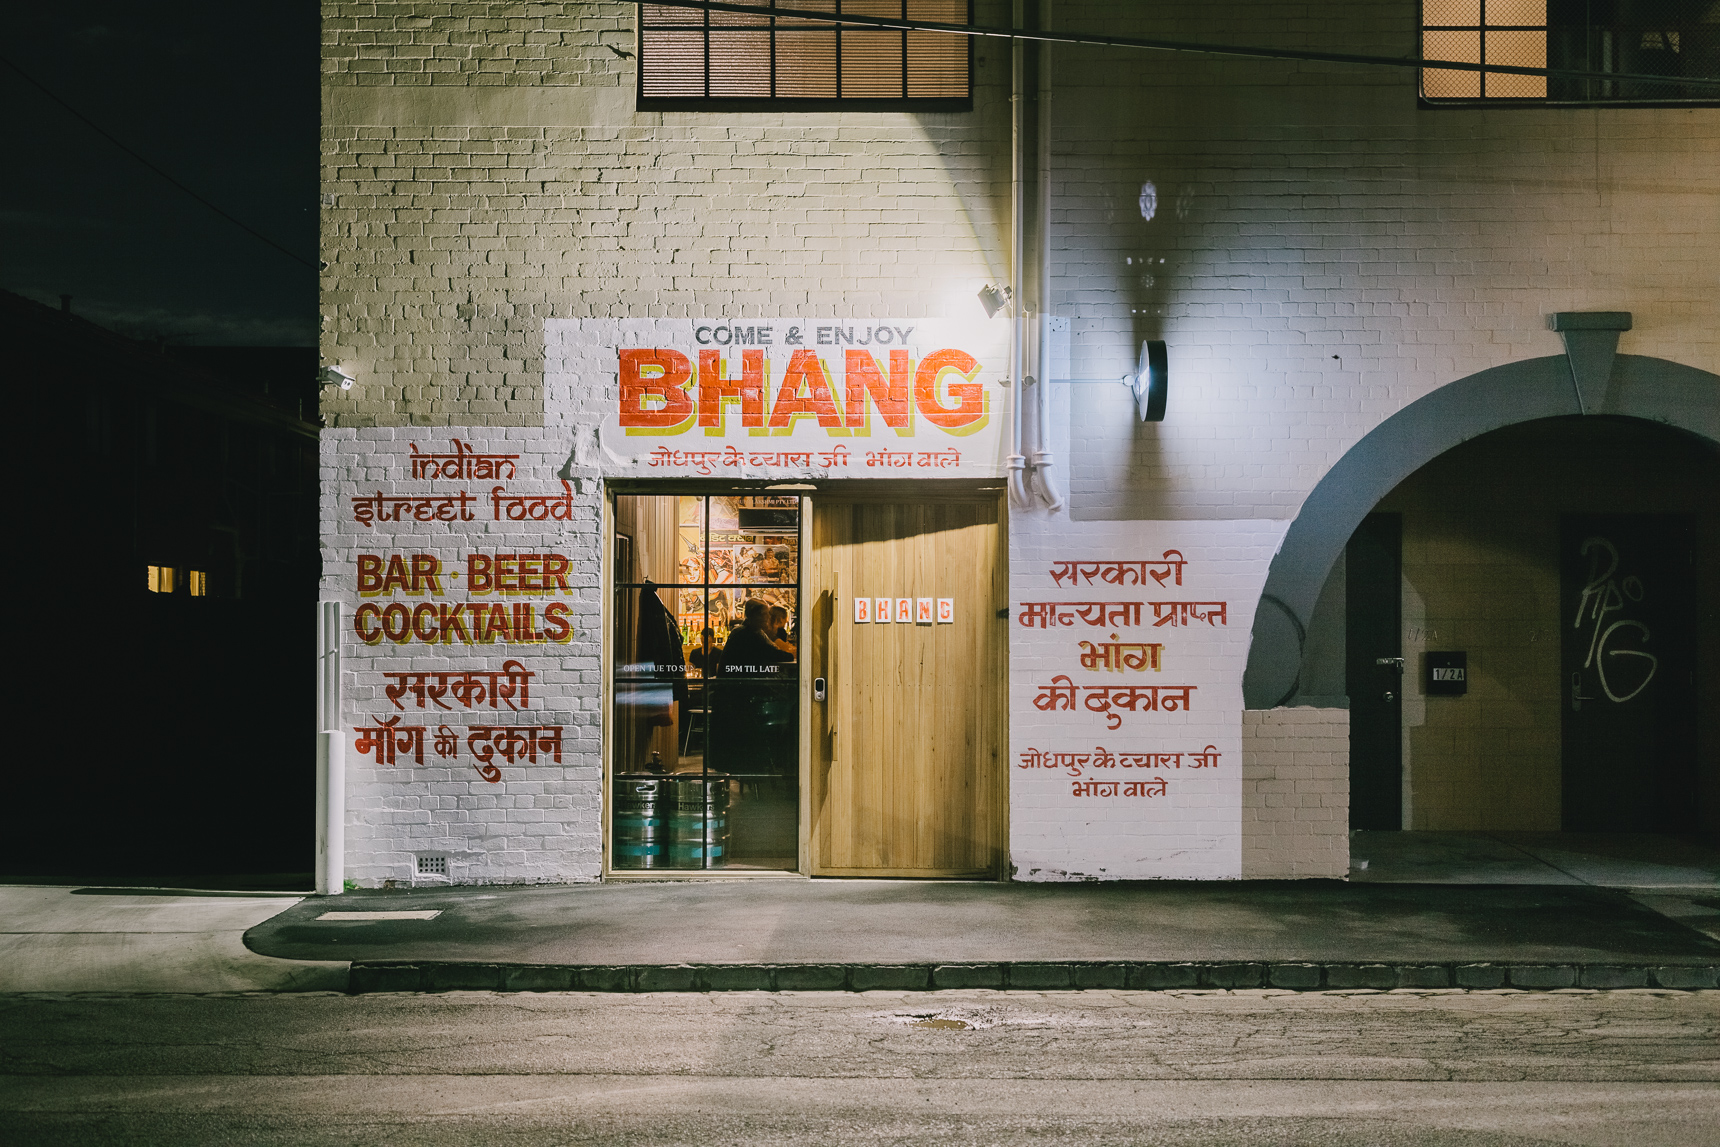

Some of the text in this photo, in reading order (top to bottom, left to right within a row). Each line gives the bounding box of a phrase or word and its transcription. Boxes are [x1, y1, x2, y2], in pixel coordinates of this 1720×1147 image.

[695, 325, 915, 346] COME & ENJOY
[618, 348, 989, 438] BHANG
[409, 438, 520, 480] indian
[722, 445, 746, 468] के
[818, 444, 851, 468] जी
[917, 447, 962, 468] वाले
[351, 478, 574, 527] street food
[357, 553, 445, 597] BAR
[467, 553, 573, 596] BEER
[1049, 549, 1188, 588] सरकारी
[354, 602, 574, 646] COCKTAILS
[858, 599, 951, 620] BHANG
[1018, 601, 1227, 629] मान्यता प्राप्त
[623, 664, 696, 673] OPEN TUE TO SUN
[725, 665, 780, 673] 5PM TIL LATE
[1078, 633, 1165, 674] भांग
[383, 659, 536, 711] सरकारी
[1435, 669, 1463, 680] 1/2A
[1033, 675, 1198, 730] की दुकान
[433, 725, 459, 759] की
[467, 726, 563, 783] दुकान
[1093, 746, 1117, 768] के
[1188, 745, 1222, 769] जी
[1123, 777, 1168, 798] वाले
